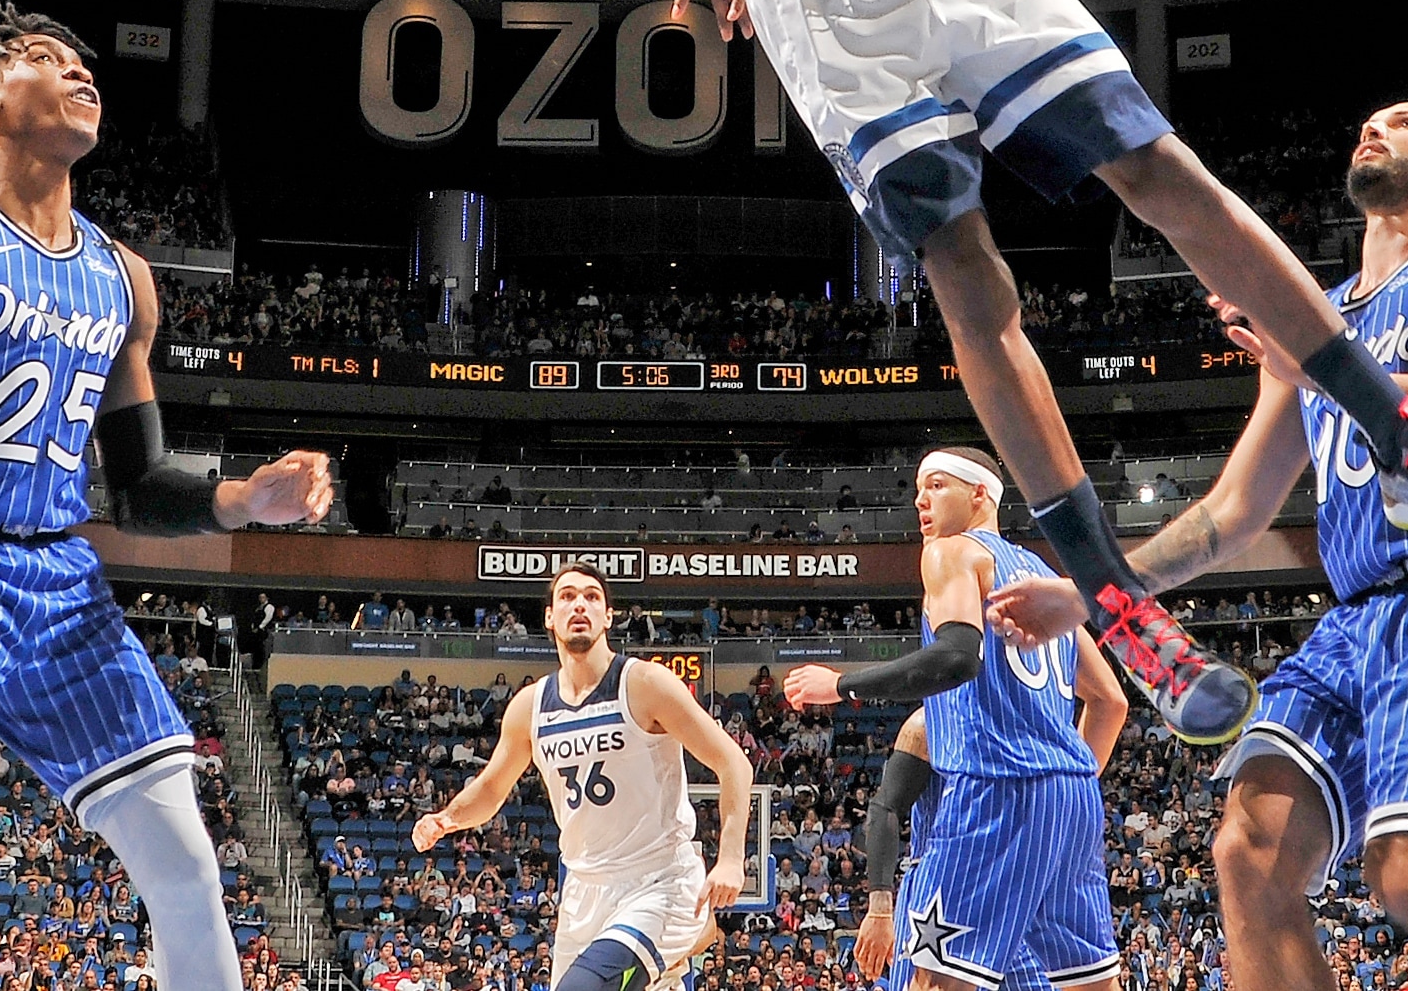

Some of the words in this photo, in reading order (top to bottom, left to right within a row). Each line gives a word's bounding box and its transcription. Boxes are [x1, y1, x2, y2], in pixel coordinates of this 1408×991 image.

[126, 30, 161, 49] 232
[1186, 41, 1221, 59] 202
[170, 344, 193, 358] TIME
[195, 347, 221, 360] OUTS
[228, 351, 243, 371] 4
[1084, 356, 1107, 369] TIME
[1109, 355, 1135, 368] OUTS
[183, 357, 206, 370] LEFT
[290, 356, 314, 372] TM
[320, 357, 360, 375] FLS:
[372, 357, 379, 378] 1
[429, 362, 505, 382] MAGIC
[710, 363, 740, 379] 3RD
[1098, 367, 1121, 380] LEFT
[1141, 355, 1157, 376] 4
[537, 365, 568, 386] 89
[621, 365, 670, 386] 5:06
[709, 381, 744, 389] PERIOD
[772, 367, 803, 387] 74
[819, 365, 919, 386] WOLVES
[484, 552, 548, 575] BUD
[648, 553, 791, 577] BASELINE
[796, 554, 858, 577] BAR
[541, 731, 626, 761] WOLVES
[557, 760, 616, 810] 36
